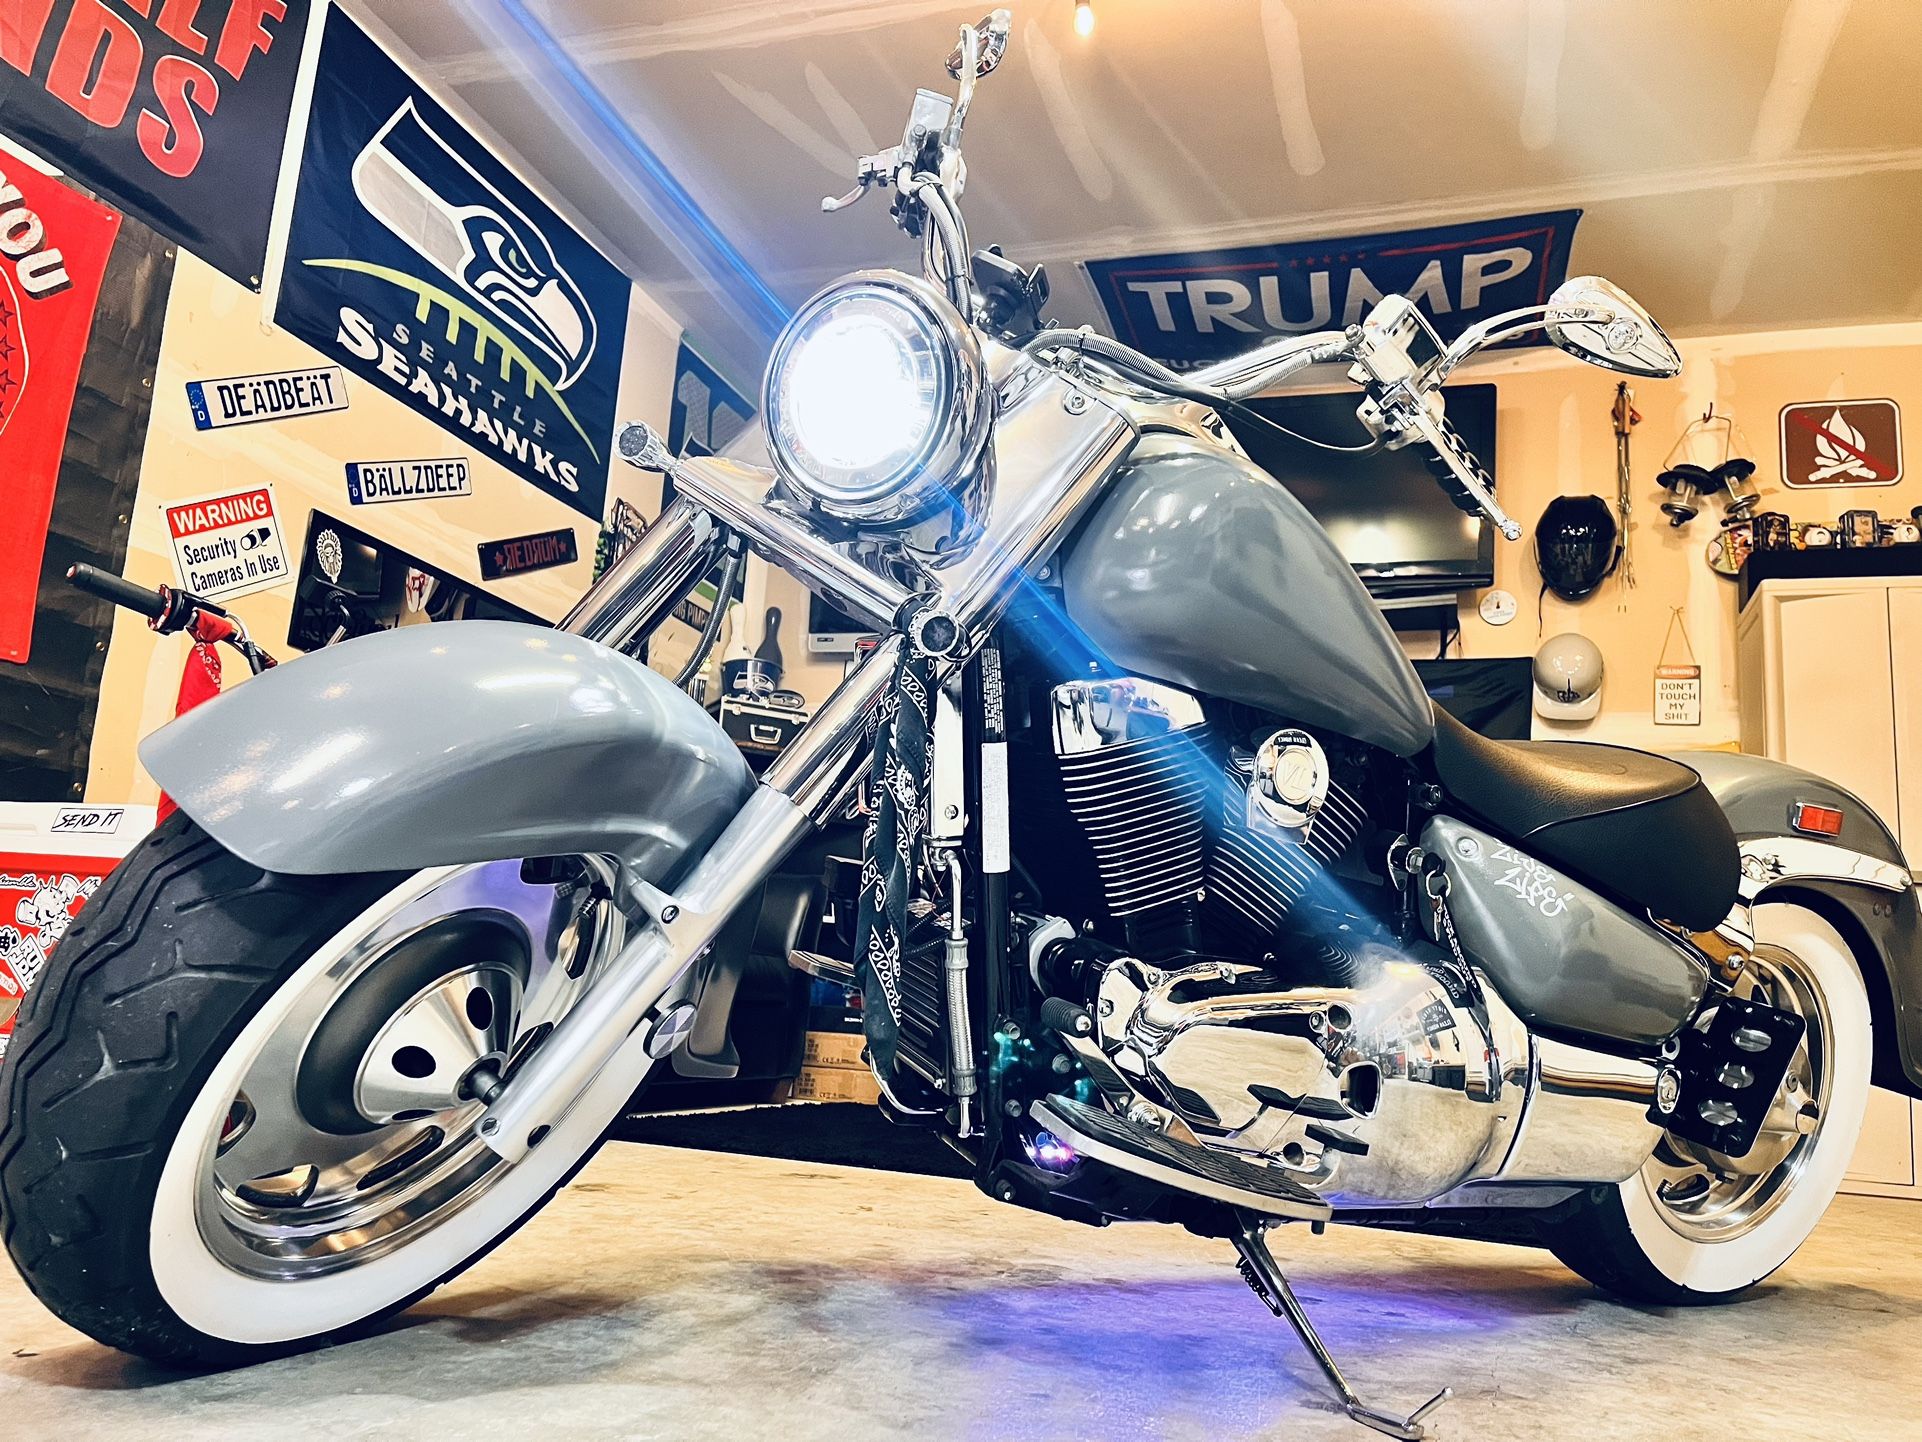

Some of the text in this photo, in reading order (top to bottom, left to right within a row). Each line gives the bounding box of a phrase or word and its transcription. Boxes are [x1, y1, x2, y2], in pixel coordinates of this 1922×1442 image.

[1126, 246, 1533, 334] TRUMP
[197, 373, 334, 421] D DEÄDBEÄT
[392, 323, 546, 437] SEATTLE
[336, 306, 579, 492] SEAHAWKS
[352, 463, 466, 497] D BÄLLZDEEP
[173, 494, 268, 534] WARNING
[183, 537, 237, 565] Security
[191, 554, 280, 592] Cameras In Use
[1659, 692, 1697, 701] TOUCH
[1661, 682, 1694, 691] DON'T
[1664, 712, 1689, 721] SHIT
[1669, 702, 1685, 710] MY
[52, 811, 123, 829] SEND IT
